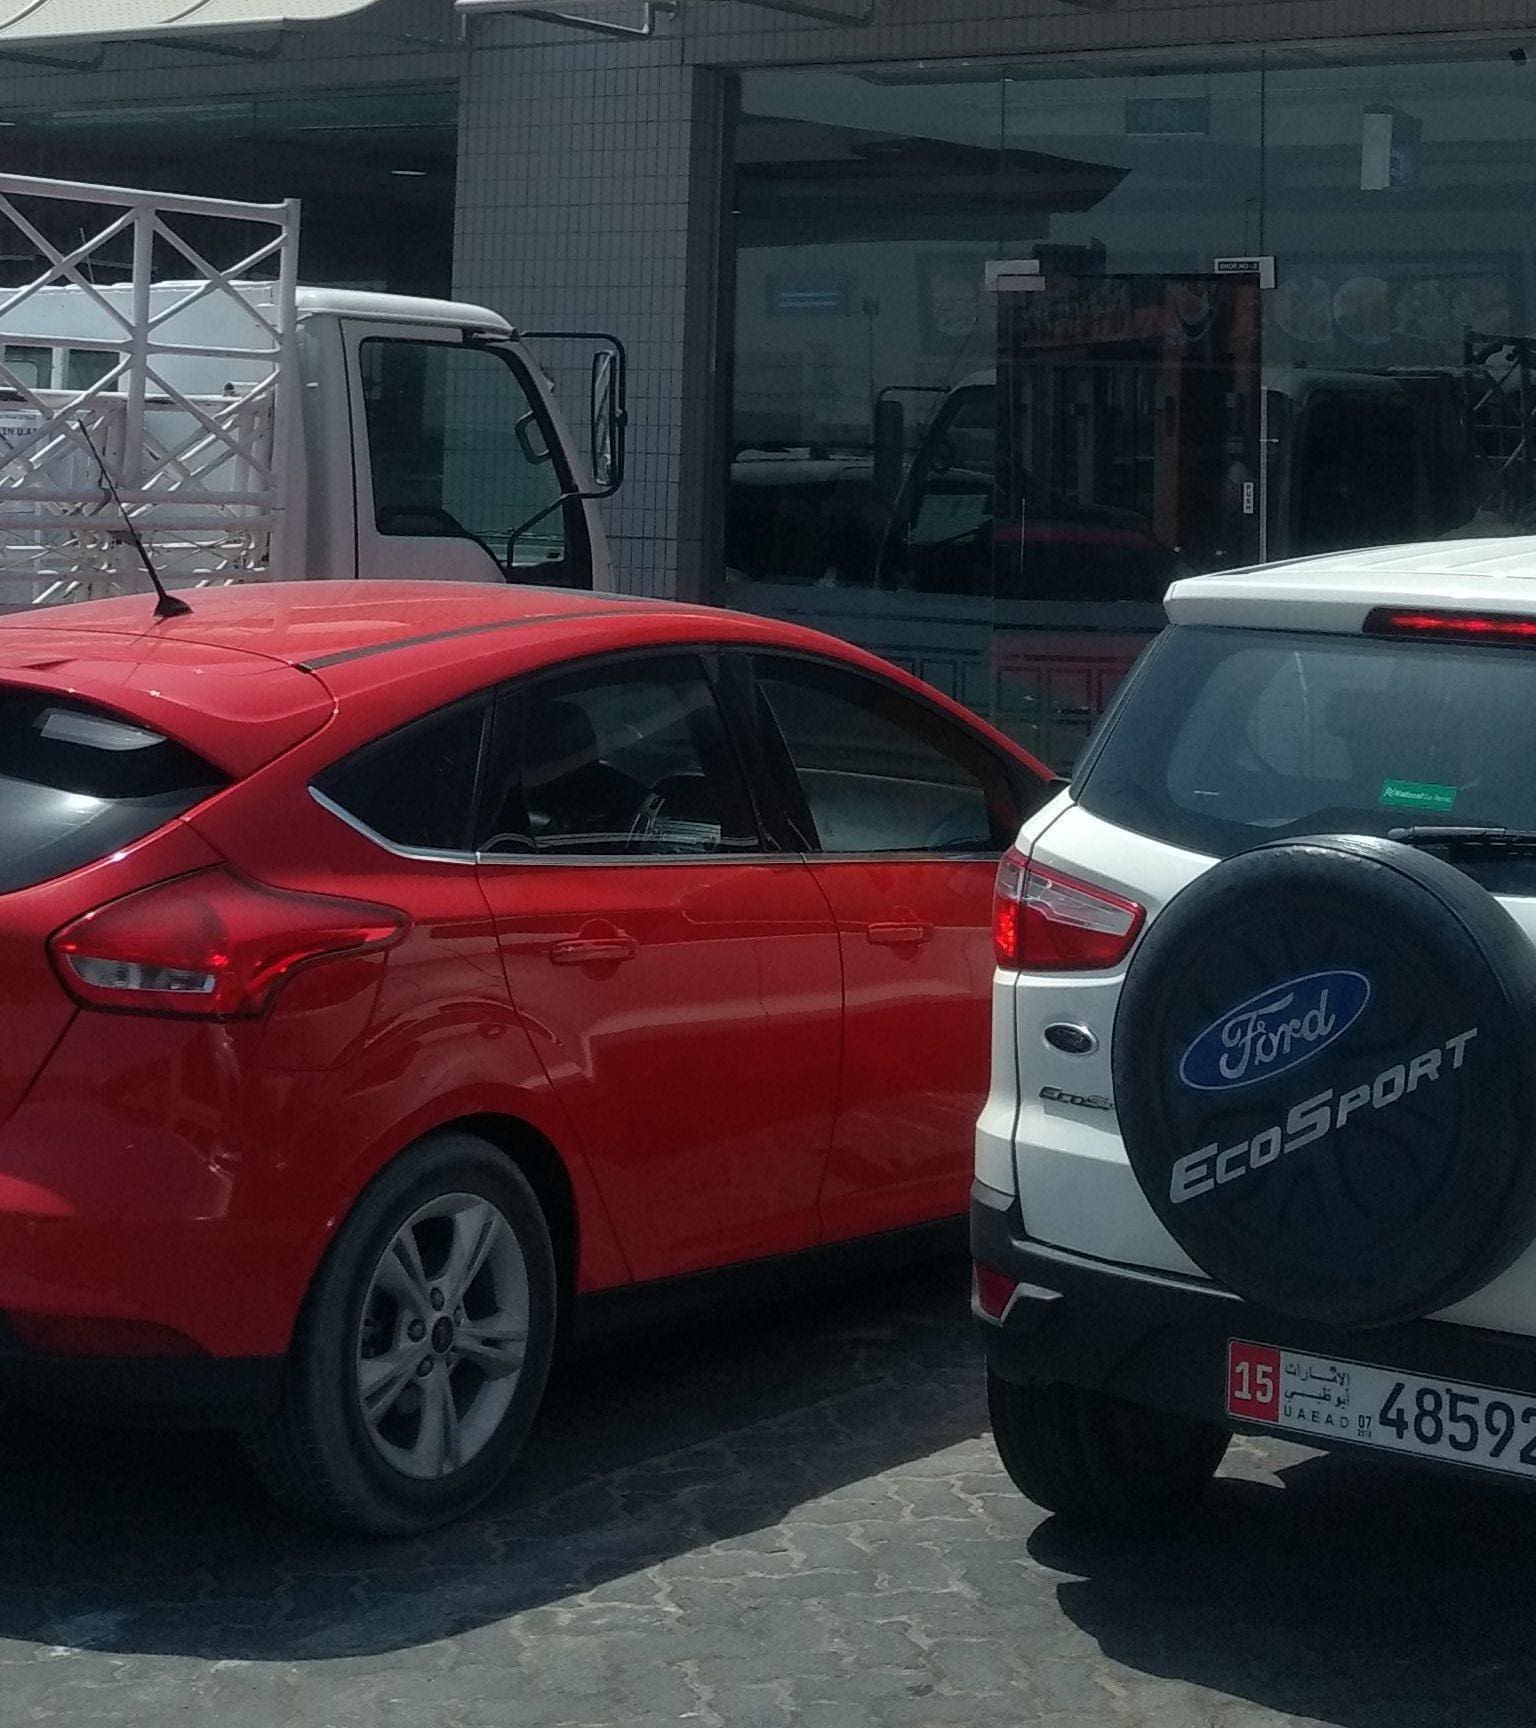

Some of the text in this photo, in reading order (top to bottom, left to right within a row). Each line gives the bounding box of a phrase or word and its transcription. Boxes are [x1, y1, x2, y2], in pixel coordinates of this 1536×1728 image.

[1218, 989, 1337, 1080] Ford
[1234, 1361, 1274, 1405] 15
[1358, 1414, 1372, 1428] 07
